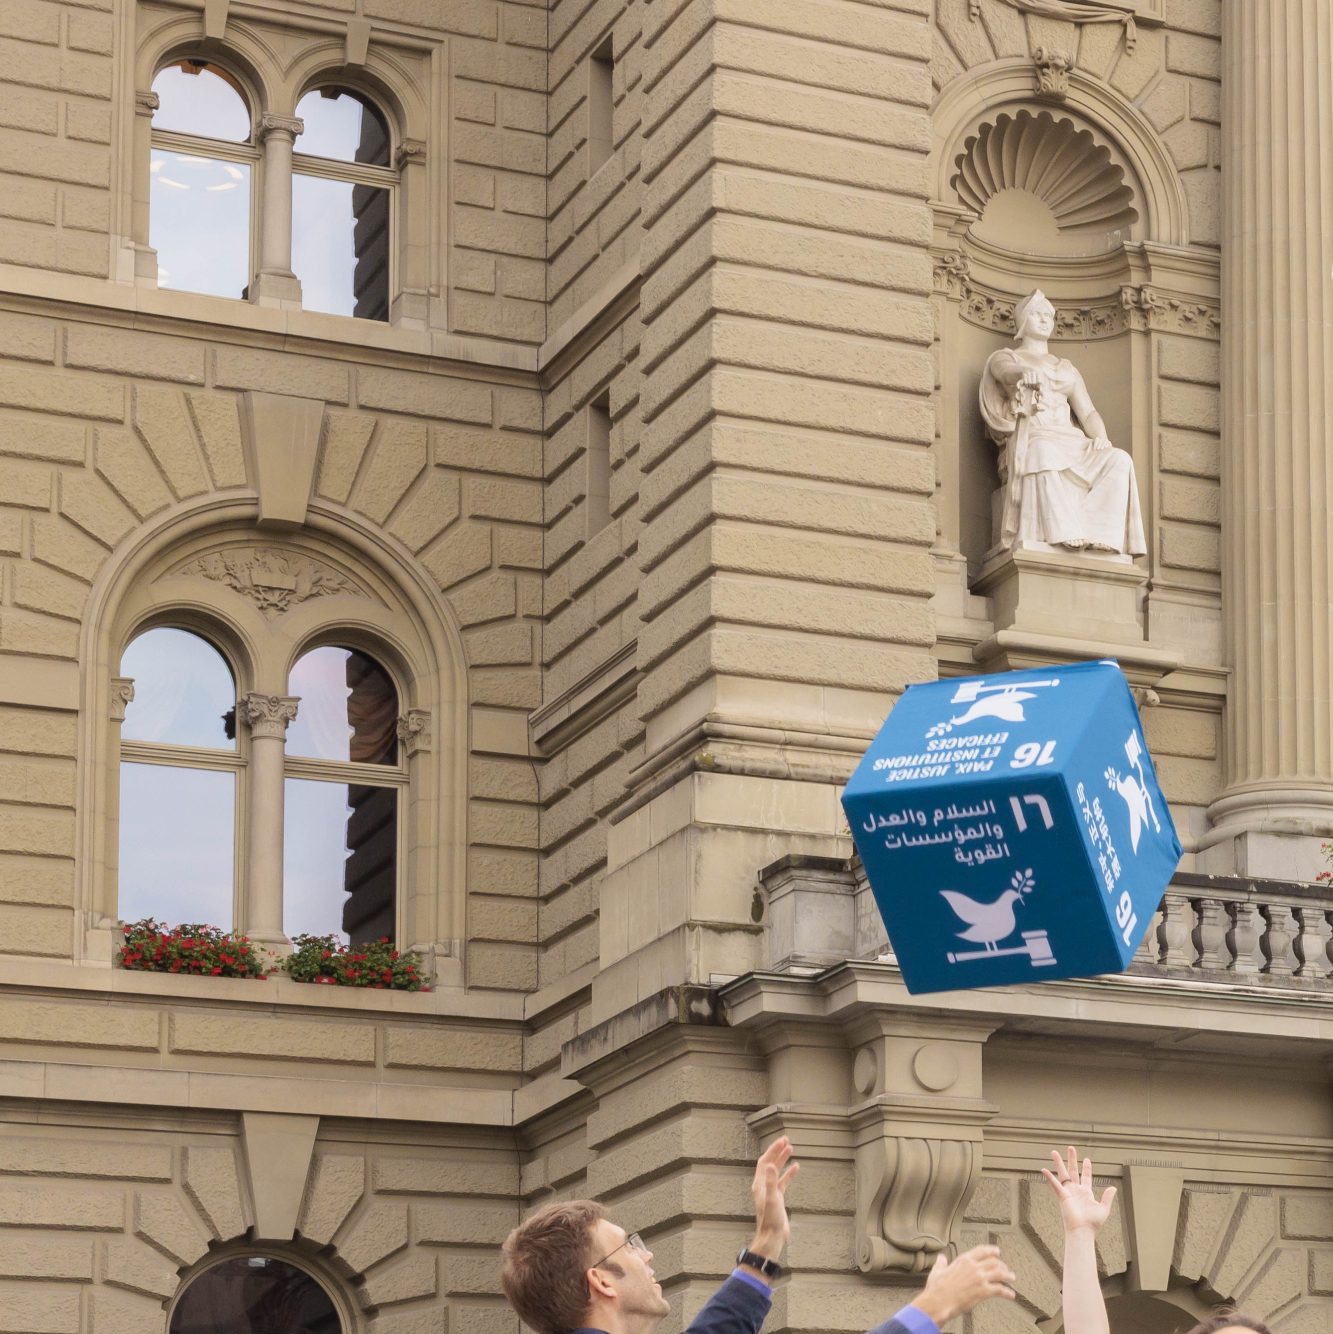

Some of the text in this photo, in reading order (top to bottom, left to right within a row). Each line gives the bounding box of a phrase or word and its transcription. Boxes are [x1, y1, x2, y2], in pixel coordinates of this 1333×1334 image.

[927, 731, 1009, 750] EFFICACES
[873, 746, 1001, 771] ET INSTITUTIONS
[1010, 739, 1057, 769] 16
[886, 758, 993, 782] PAIX, JUSTICE
[863, 800, 996, 832] السلام والعدل
[885, 824, 1003, 850] والمؤسسات
[955, 843, 1010, 865] القوية
[1115, 890, 1139, 947] 16
